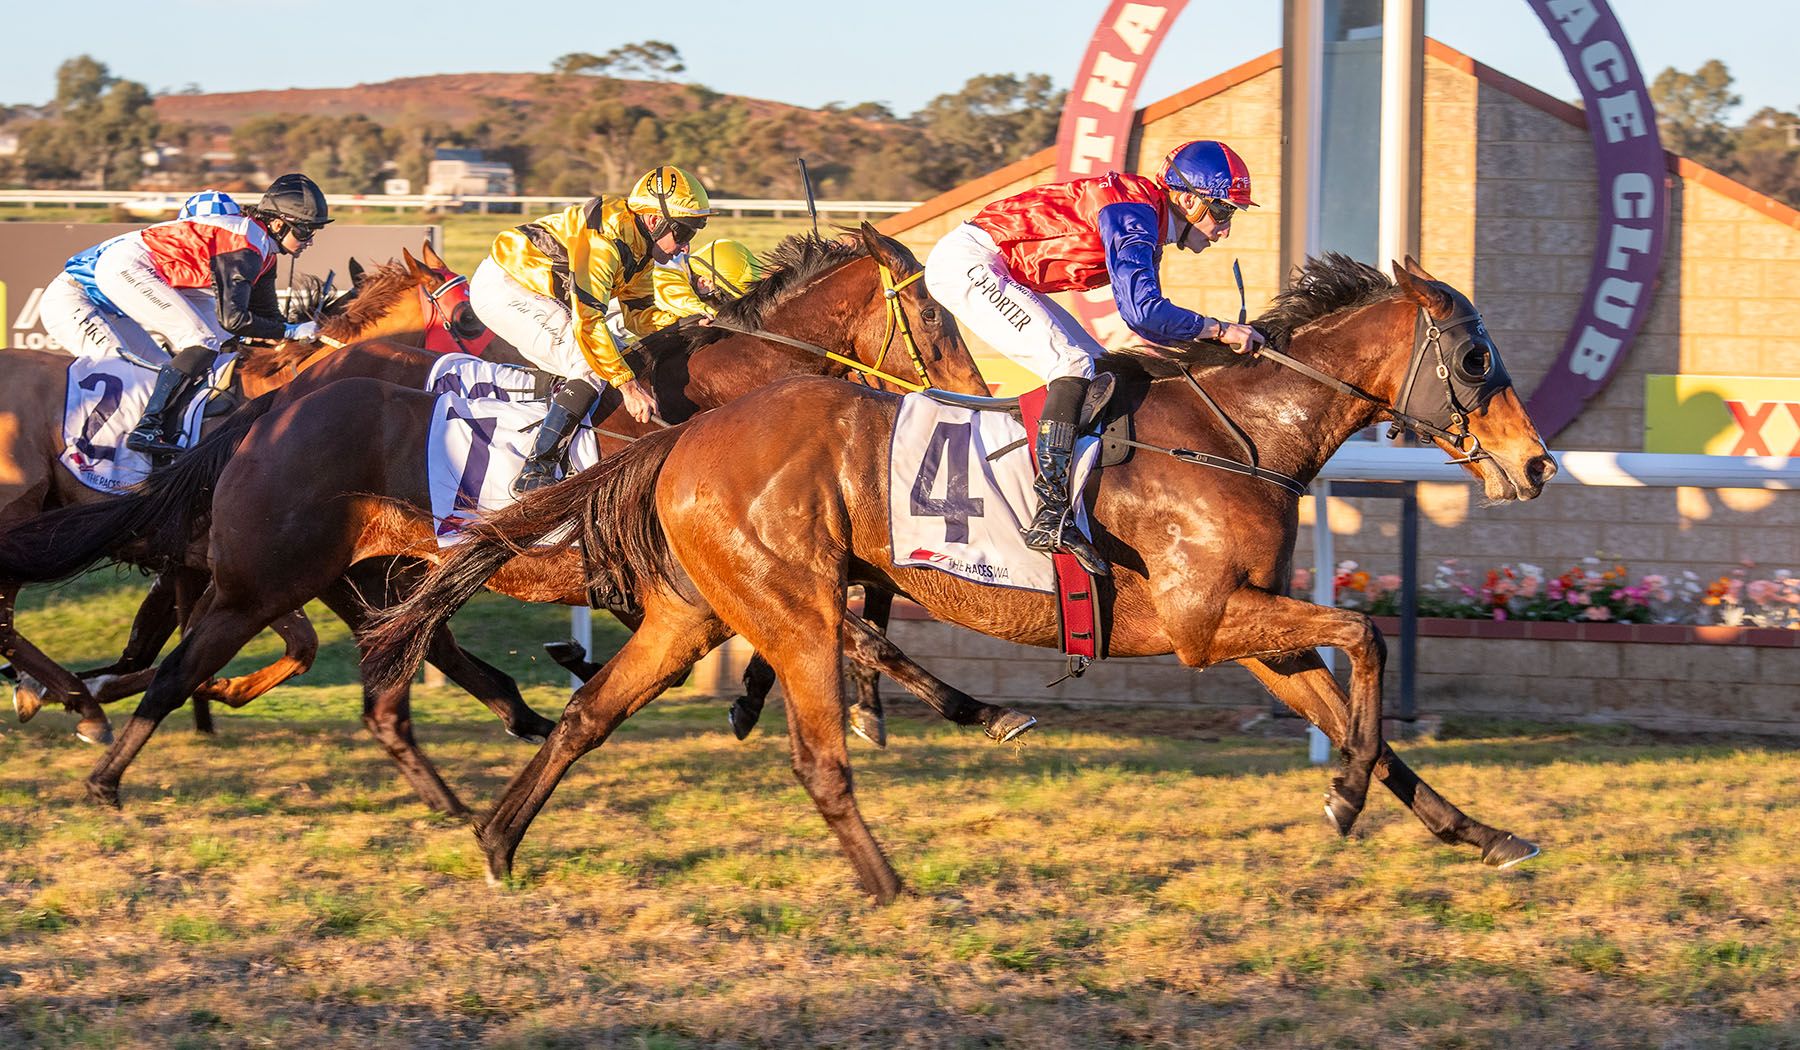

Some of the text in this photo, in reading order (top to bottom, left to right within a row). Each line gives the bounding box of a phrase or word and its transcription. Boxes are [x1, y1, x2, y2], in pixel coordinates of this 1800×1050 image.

[1546, 0, 1655, 381] ACE CLUB
[14, 332, 64, 350] LOG
[982, 282, 1032, 332] PORTER
[76, 372, 124, 461] 2
[446, 406, 497, 511] 7
[910, 421, 985, 544] 4
